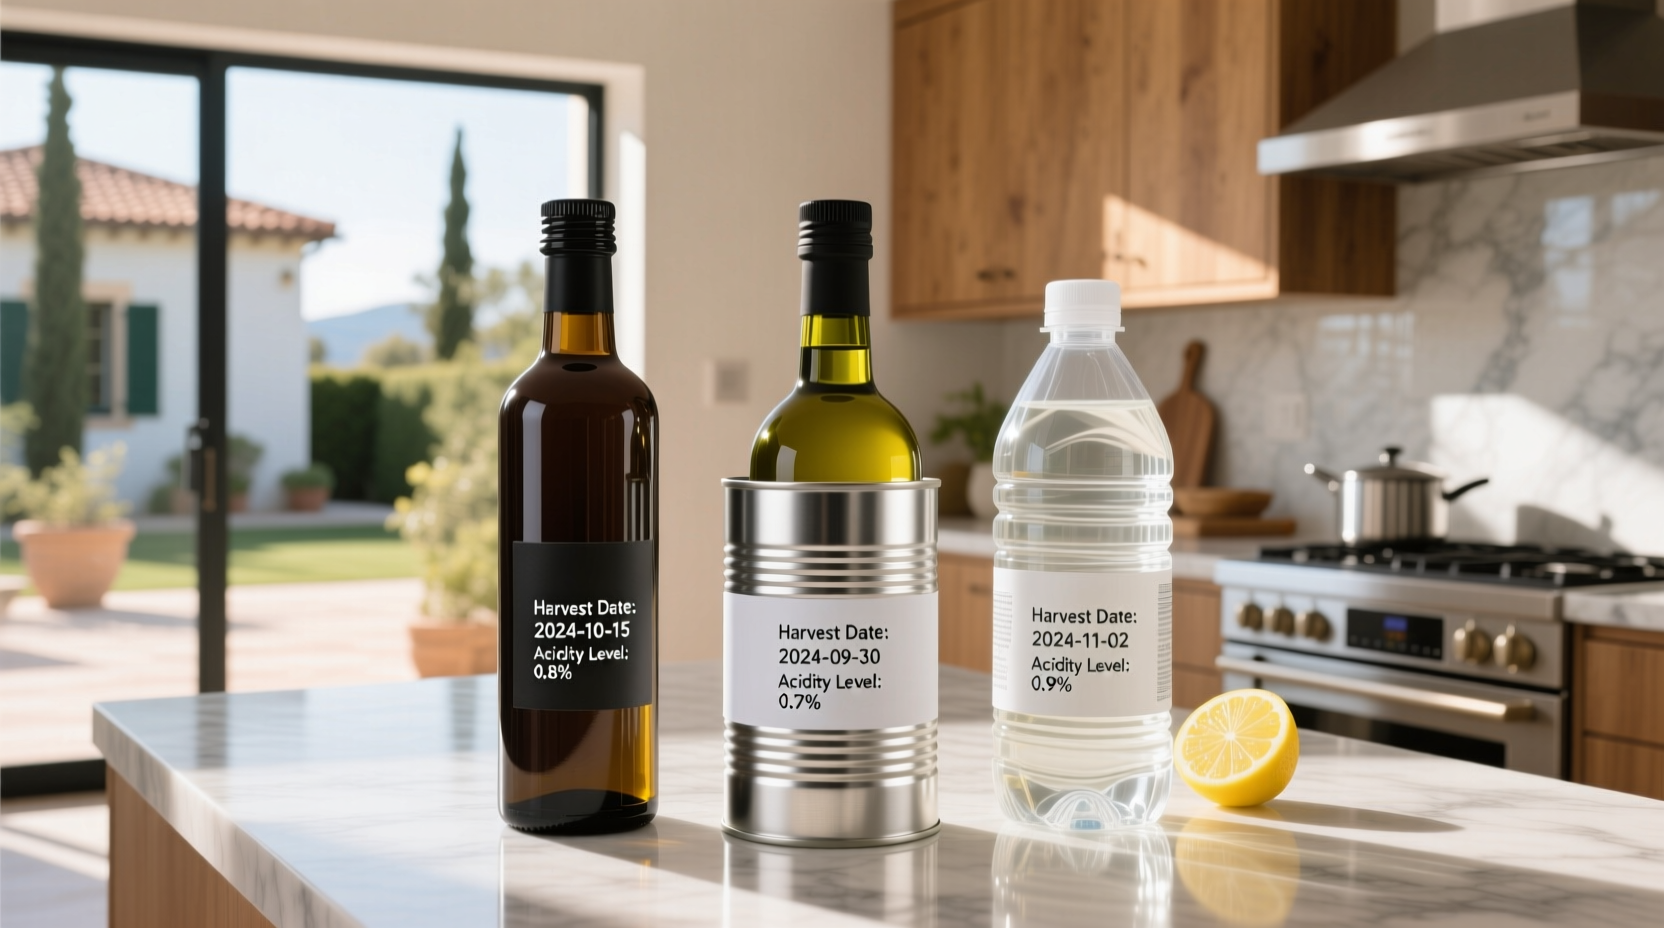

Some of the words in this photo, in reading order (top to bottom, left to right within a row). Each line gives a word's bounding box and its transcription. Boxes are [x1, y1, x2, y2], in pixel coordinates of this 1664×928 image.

[534, 599, 593, 616] Harvest
[598, 599, 636, 615] Date:
[1032, 606, 1091, 624] Harvest
[1096, 608, 1137, 624] Date:
[534, 621, 630, 639] 2024-10-15
[779, 624, 840, 640] Harvest
[846, 624, 889, 640] Date:
[1032, 630, 1129, 648] 2024-11-02
[589, 645, 628, 661] Level:
[779, 648, 880, 664] 2024-09-30
[533, 663, 572, 680] 0.8%
[1031, 656, 1082, 676] Acidity
[1087, 658, 1130, 673] Level:
[778, 673, 831, 693] Acidity
[836, 673, 881, 689] Level:
[1031, 675, 1072, 692] 0.9%
[778, 693, 821, 710] 0.7%
